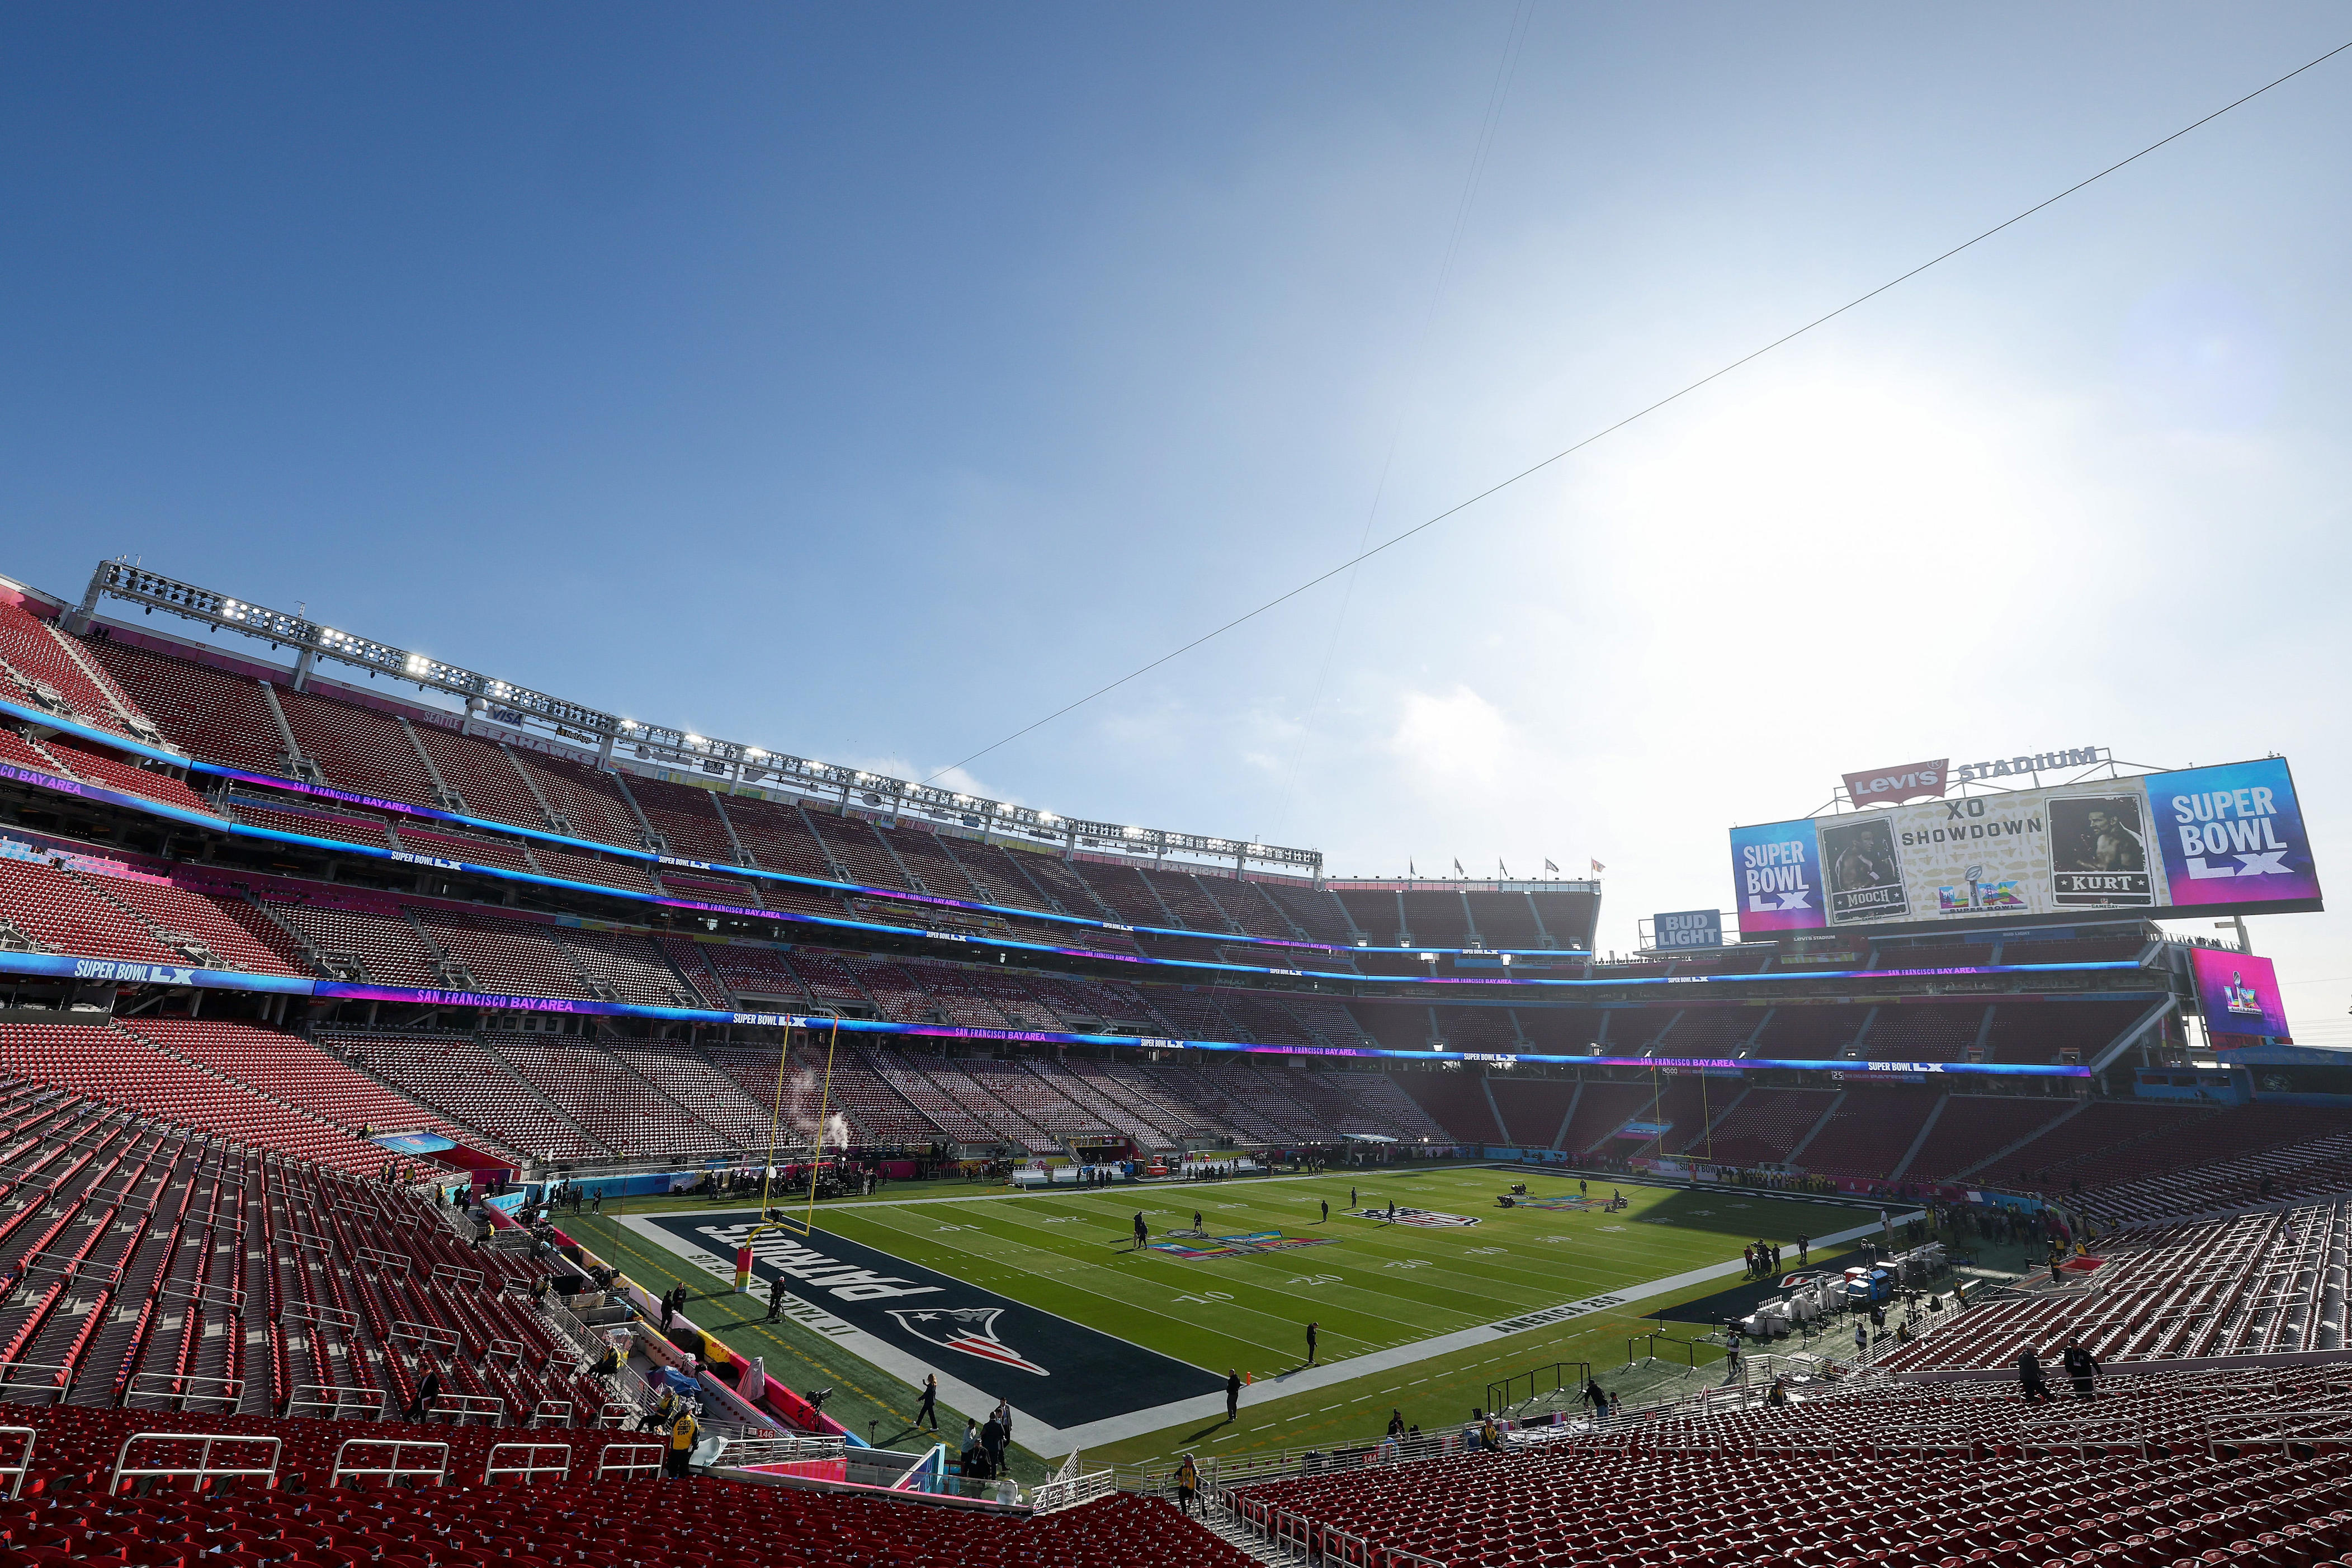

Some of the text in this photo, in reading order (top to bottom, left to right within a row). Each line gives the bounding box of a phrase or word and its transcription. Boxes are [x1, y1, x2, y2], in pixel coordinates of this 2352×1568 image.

[423, 711, 460, 728] SEATTLE
[492, 709, 522, 726] VISA
[470, 724, 598, 766] SEAHAWKS
[565, 730, 593, 744] NetApp
[703, 766, 724, 774] LIGHT
[1957, 746, 2098, 782] STADIUM
[18, 769, 82, 795] BAY AREA
[293, 782, 412, 813] SAN FRANCISCO BAY AREA
[2172, 787, 2277, 823] SUPER
[1944, 799, 1985, 820] XO
[896, 817, 913, 828] SUPER
[913, 820, 928, 830] BOWL
[1902, 818, 2042, 846] SHOWDOWN
[2179, 818, 2288, 856] BOWL
[391, 851, 462, 871] SUPER BOWL LX
[1743, 840, 1805, 868] SUPER
[658, 856, 711, 870] SUPER BOWL LX
[1121, 858, 1155, 869] NEW ENGLAND
[1161, 863, 1230, 878] PATRIOTS
[2185, 851, 2295, 880] LX
[1746, 865, 1810, 894] BOWL
[2071, 876, 2132, 891] KURT
[907, 894, 932, 903] FRANCISCO
[1749, 891, 1812, 912] LX
[1846, 889, 1890, 908] MOOCH
[710, 904, 743, 914] FRANCISCO
[745, 908, 761, 917] BAY
[1665, 914, 1708, 931] BUD
[1659, 928, 1718, 946] LIGHT
[900, 957, 930, 966] FRANCISCO
[930, 959, 945, 969] BAY
[945, 961, 963, 970] AREA
[74, 960, 196, 985] SUPER BOWL LX
[417, 989, 574, 1012] SAN FRANCISCO BAY AREA
[733, 1013, 807, 1027] SUPER BOWL LX
[955, 1028, 1046, 1041] SAN FRANCISCO BAY AREA
[1141, 1038, 1155, 1047] SUPER
[1167, 1040, 1184, 1049] LX
[1295, 1046, 1324, 1055] FRANCISCO
[1868, 1062, 1945, 1073] SUPER BOWL LX
[1679, 1162, 1700, 1172] SUR
[1207, 1241, 1325, 1258] SUPER BOWL
[695, 1222, 947, 1302] PATRIOTS
[1297, 1273, 1344, 1286] 20
[688, 1254, 857, 1336] IT TAKES OF US
[1181, 1290, 1235, 1305] 10
[1489, 1296, 1627, 1334] AMERICA 250
[758, 1430, 774, 1439] 146
